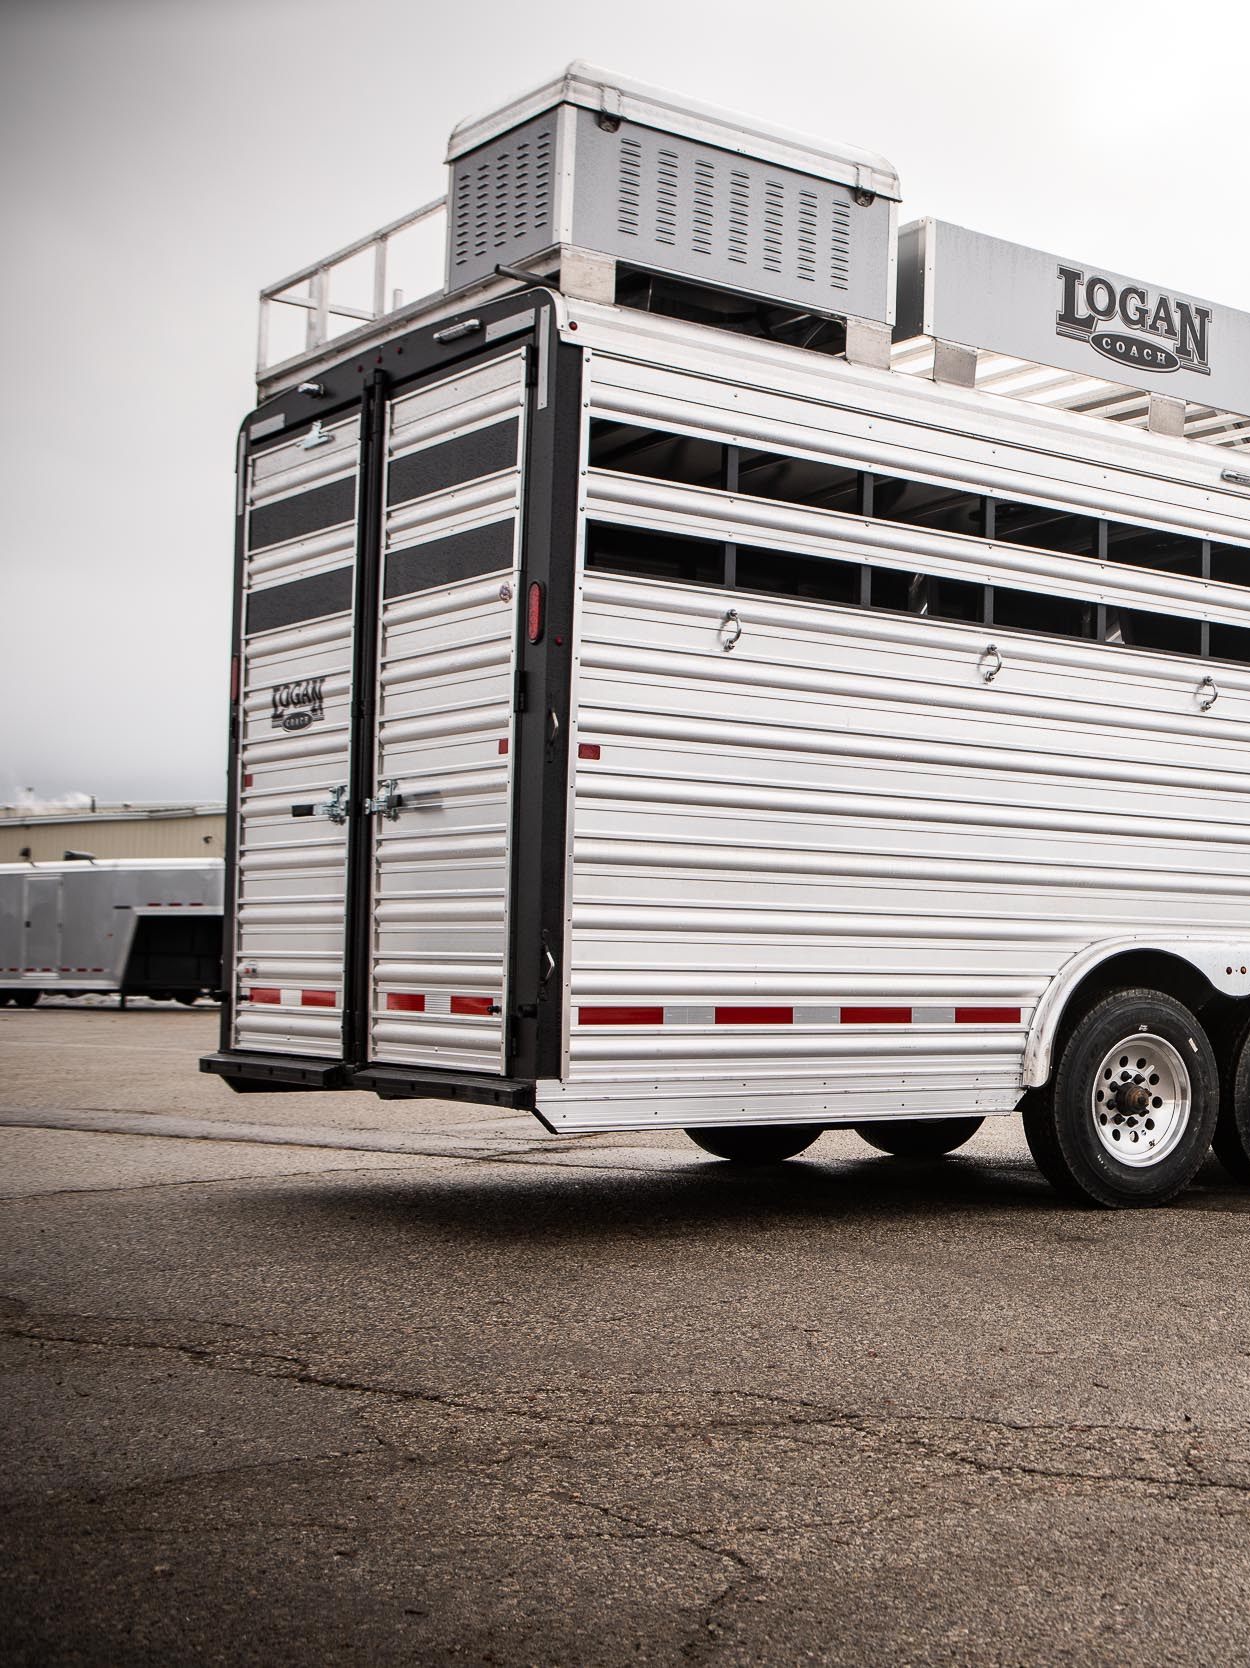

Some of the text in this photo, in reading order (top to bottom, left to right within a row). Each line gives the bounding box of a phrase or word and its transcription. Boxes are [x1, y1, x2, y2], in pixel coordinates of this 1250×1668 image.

[1056, 264, 1212, 366] LOGAN
[1102, 338, 1166, 365] COACH
[272, 678, 325, 719] LOGAN
